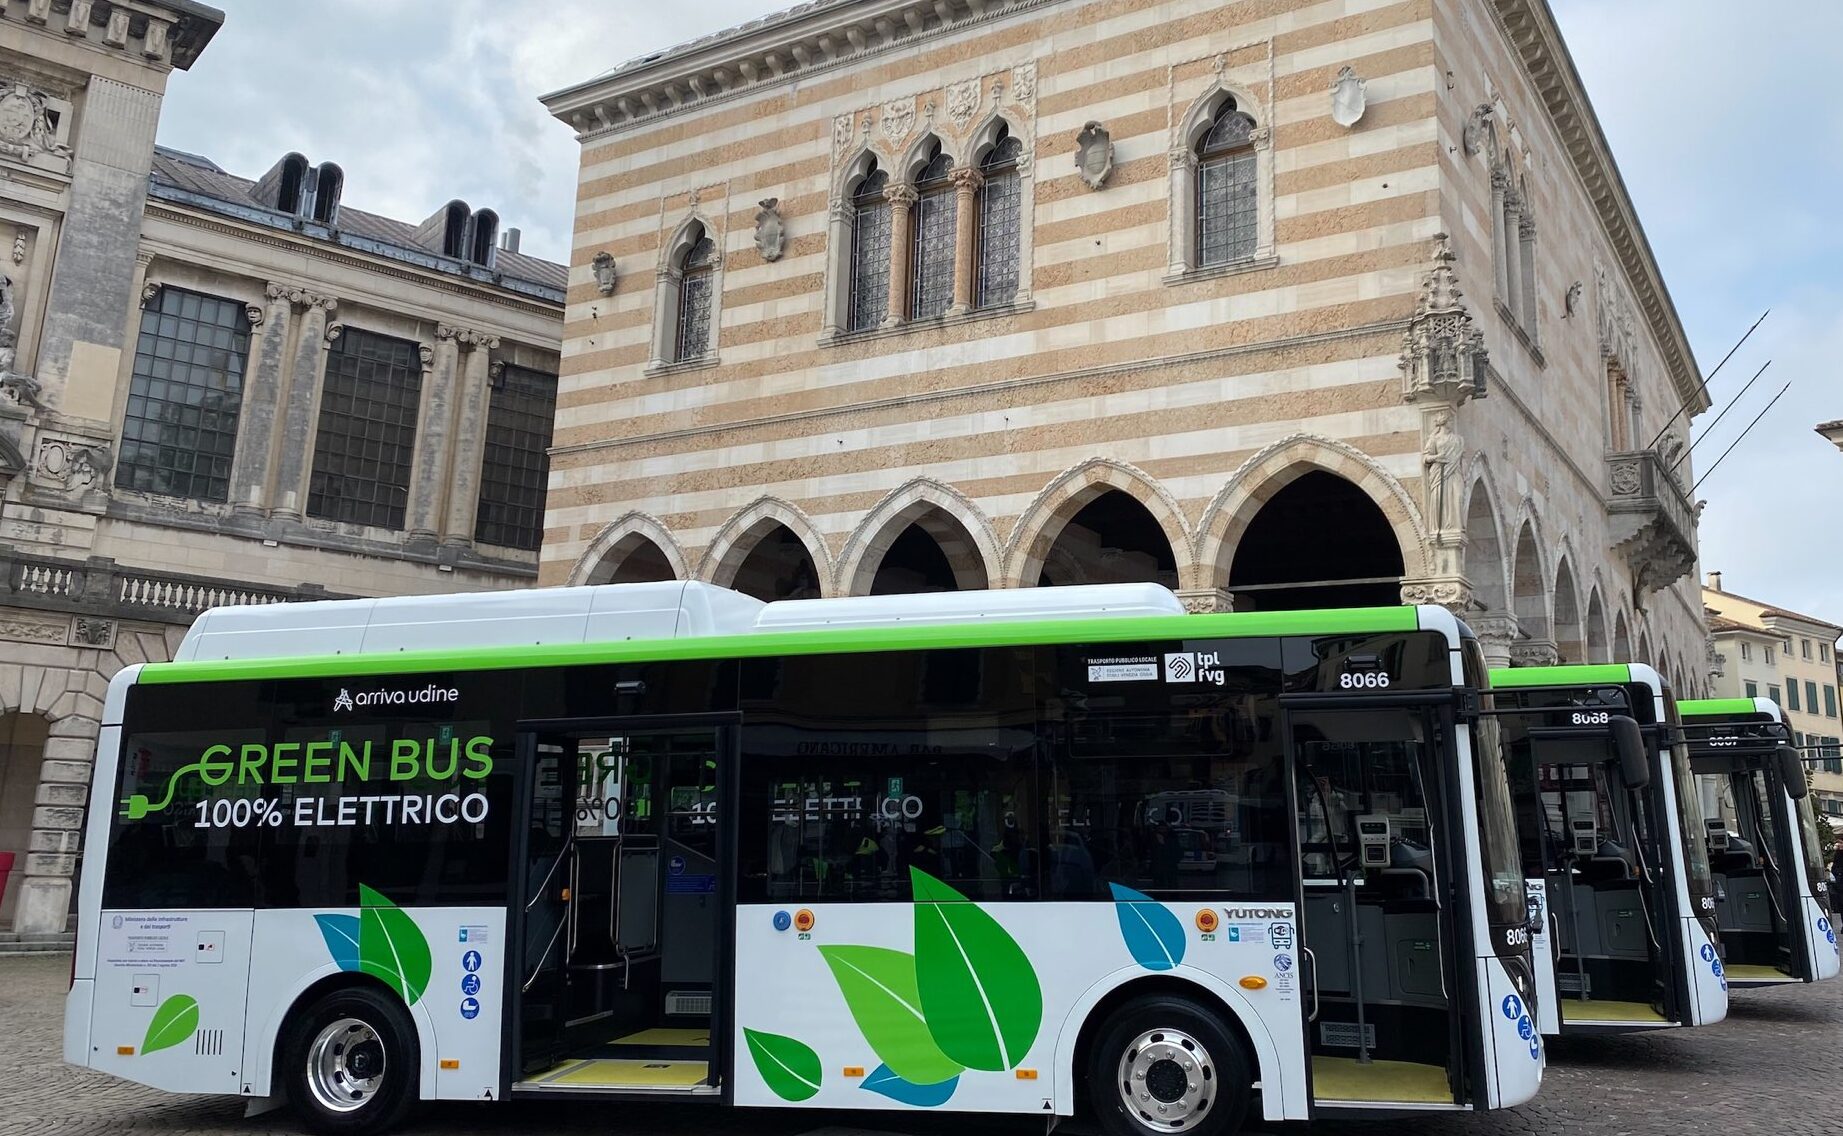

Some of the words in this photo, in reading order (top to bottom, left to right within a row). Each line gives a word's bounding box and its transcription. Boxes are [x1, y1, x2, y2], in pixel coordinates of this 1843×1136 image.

[1196, 652, 1220, 669] tpl
[1198, 668, 1225, 685] fvg
[1340, 672, 1390, 688] 8066
[355, 688, 405, 705] arriva
[408, 684, 459, 703] udine
[1572, 712, 1609, 724] 8068
[200, 739, 372, 786] GREEN
[389, 735, 496, 782] BUS
[194, 798, 282, 828] 100%
[294, 793, 489, 826] ELETTRICO
[1224, 908, 1293, 919] YUTONG
